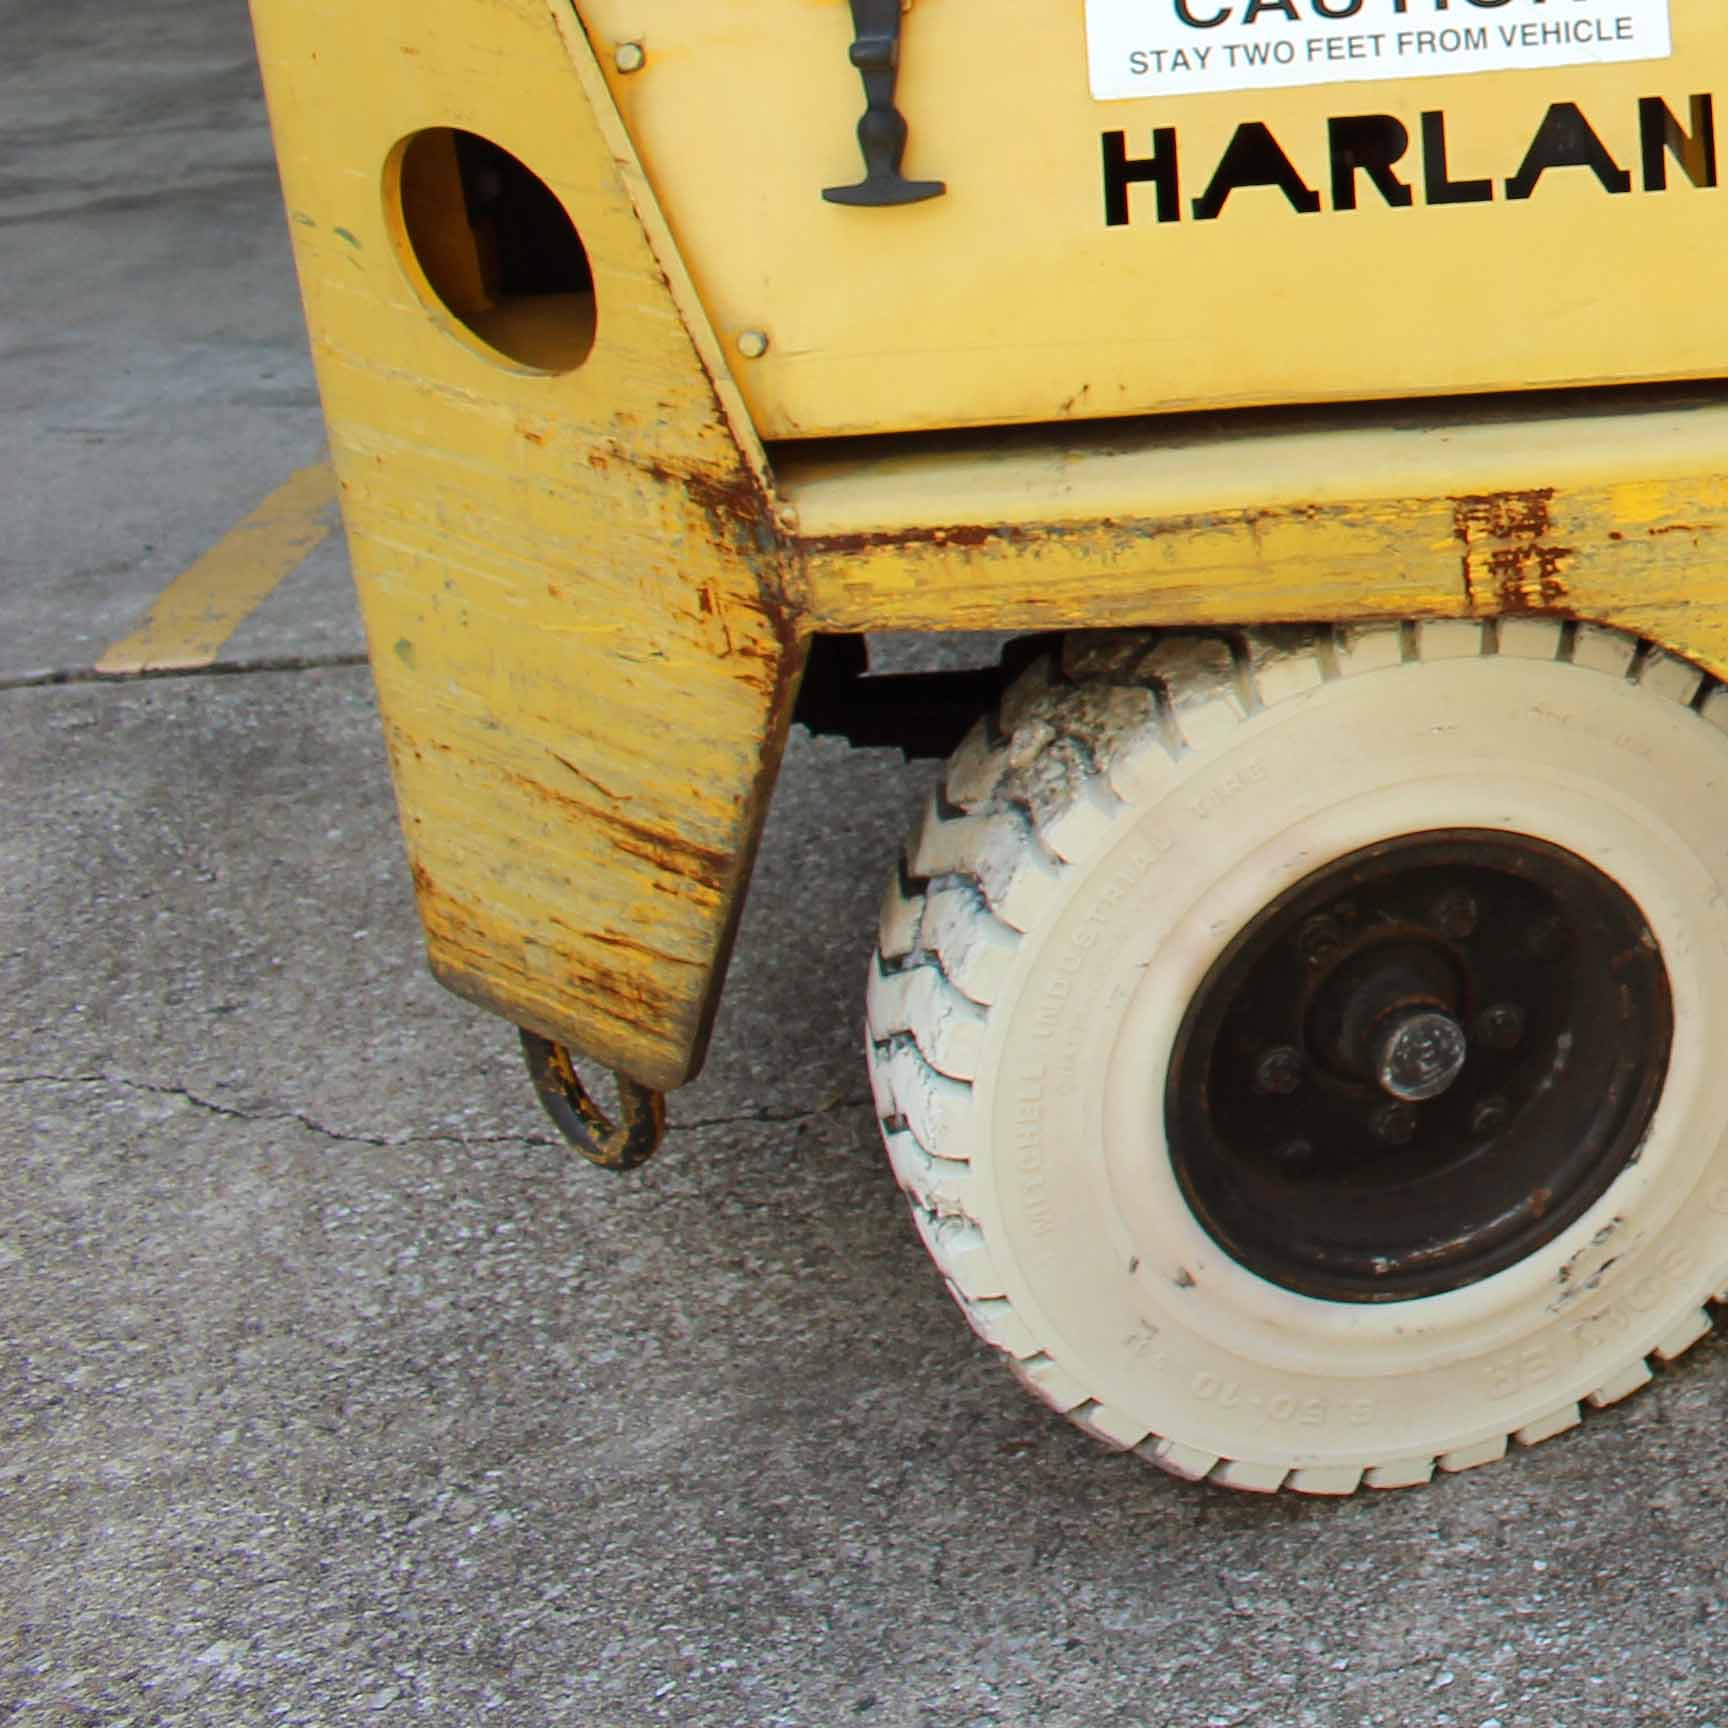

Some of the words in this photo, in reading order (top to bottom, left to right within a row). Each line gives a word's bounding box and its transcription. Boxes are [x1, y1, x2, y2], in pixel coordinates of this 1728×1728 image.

[1129, 46, 1210, 76] STAY
[1221, 40, 1295, 68] TWO
[1305, 34, 1386, 63] FEET
[1397, 25, 1489, 55] FROM
[1498, 16, 1635, 49] VEHICLE
[1101, 92, 1719, 228] HARLAN
